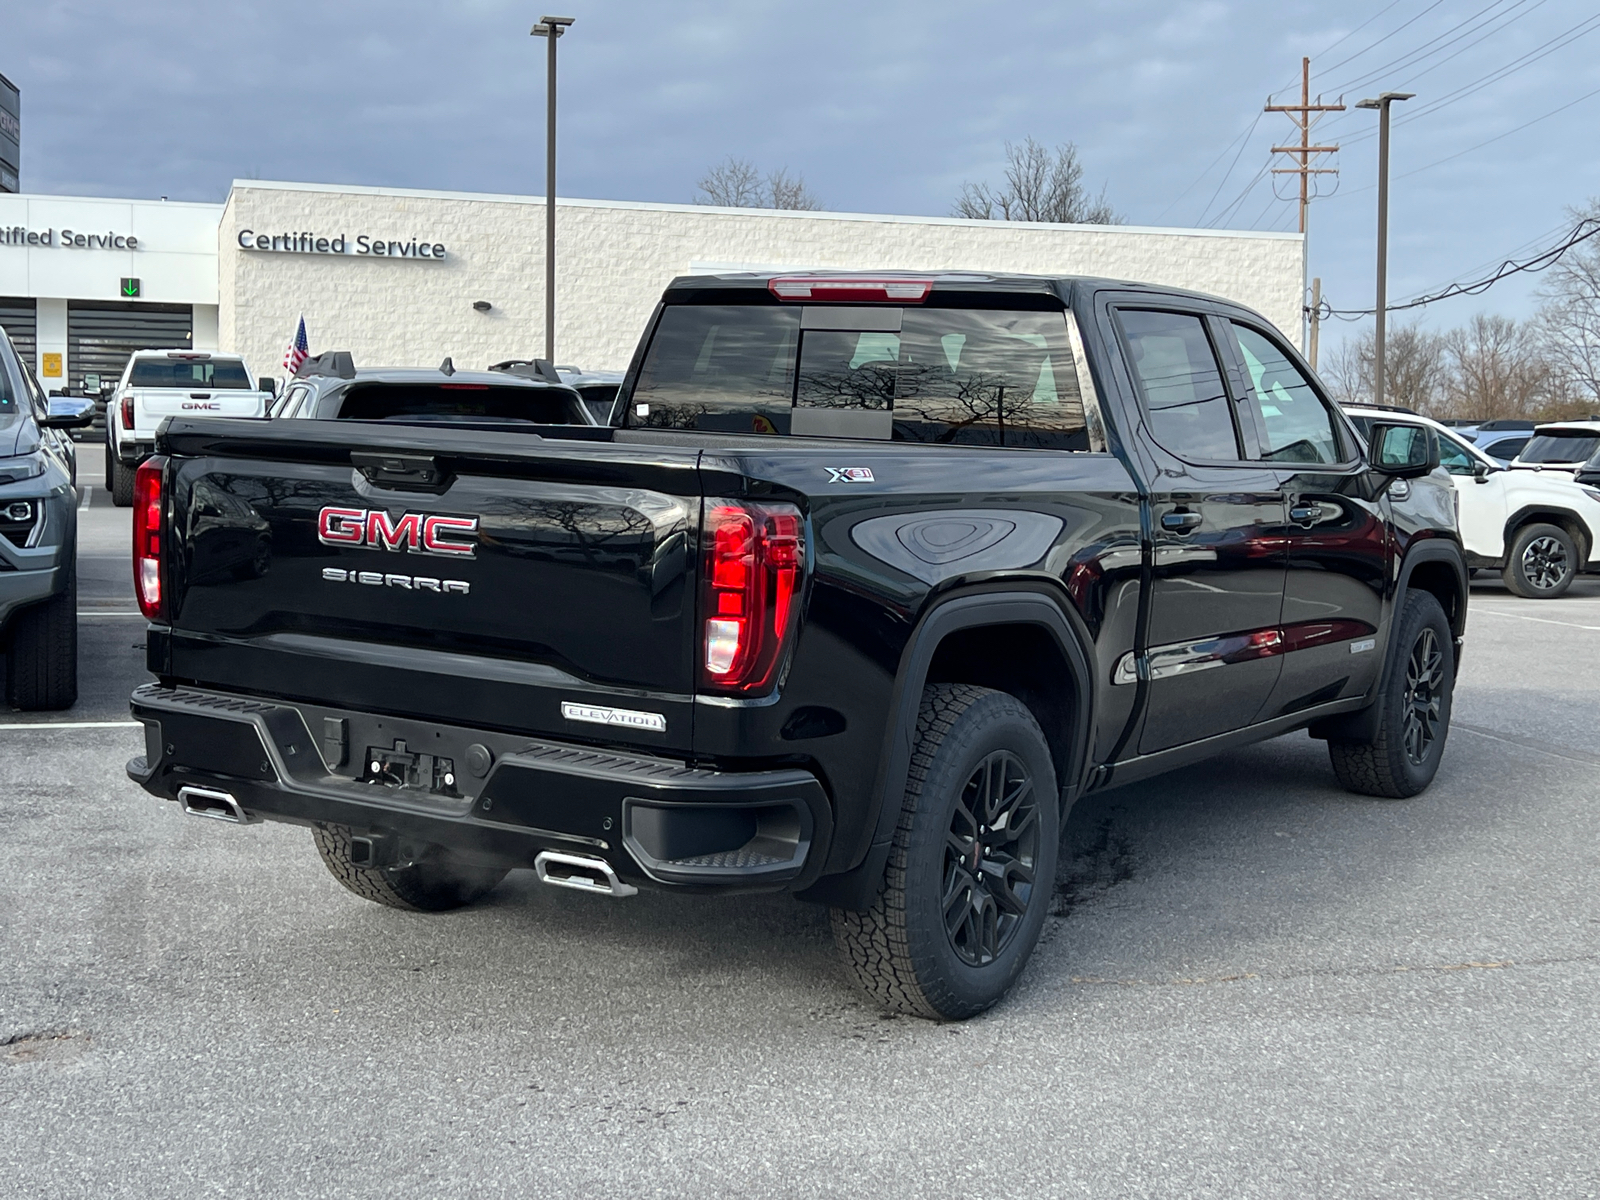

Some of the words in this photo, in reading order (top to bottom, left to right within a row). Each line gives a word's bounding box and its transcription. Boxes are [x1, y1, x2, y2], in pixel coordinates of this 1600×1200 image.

[61, 229, 138, 249] Service
[237, 229, 345, 253] Certified
[356, 235, 446, 258] Service
[181, 402, 220, 410] GMC
[318, 506, 479, 560] GMC
[322, 567, 471, 595] SIERRA
[568, 707, 658, 727] ELEVATION
